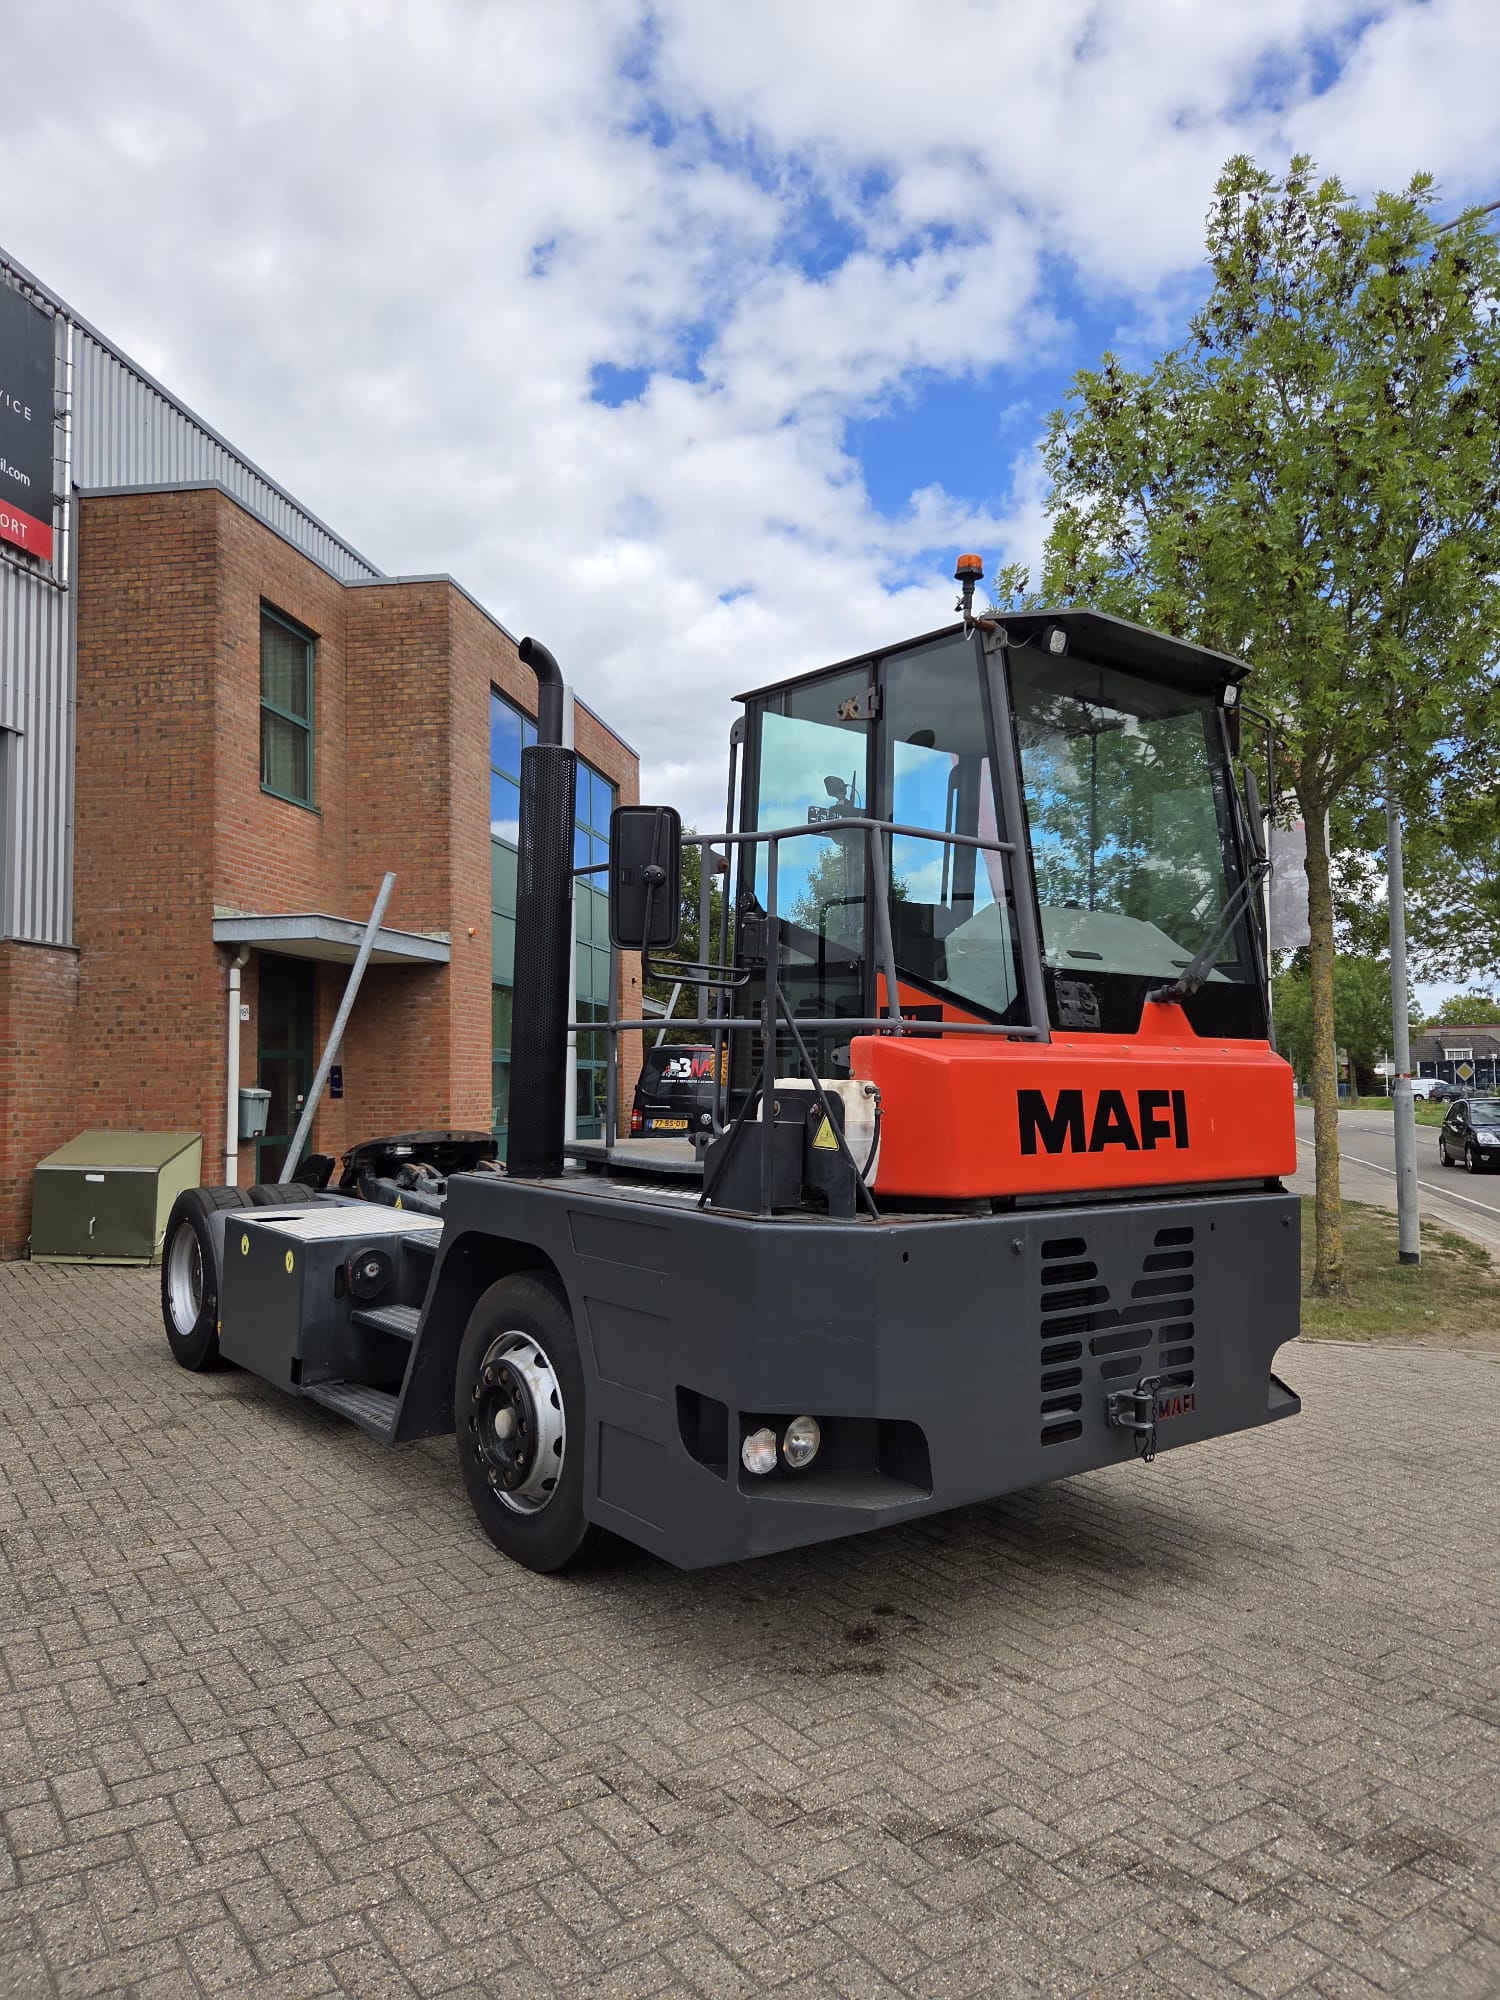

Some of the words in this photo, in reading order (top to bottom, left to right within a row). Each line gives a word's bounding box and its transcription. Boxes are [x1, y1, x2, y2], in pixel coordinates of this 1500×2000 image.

[0, 513, 28, 538] ORT
[1016, 1089, 1190, 1155] MAFI
[1158, 1393, 1196, 1419] MAFI
